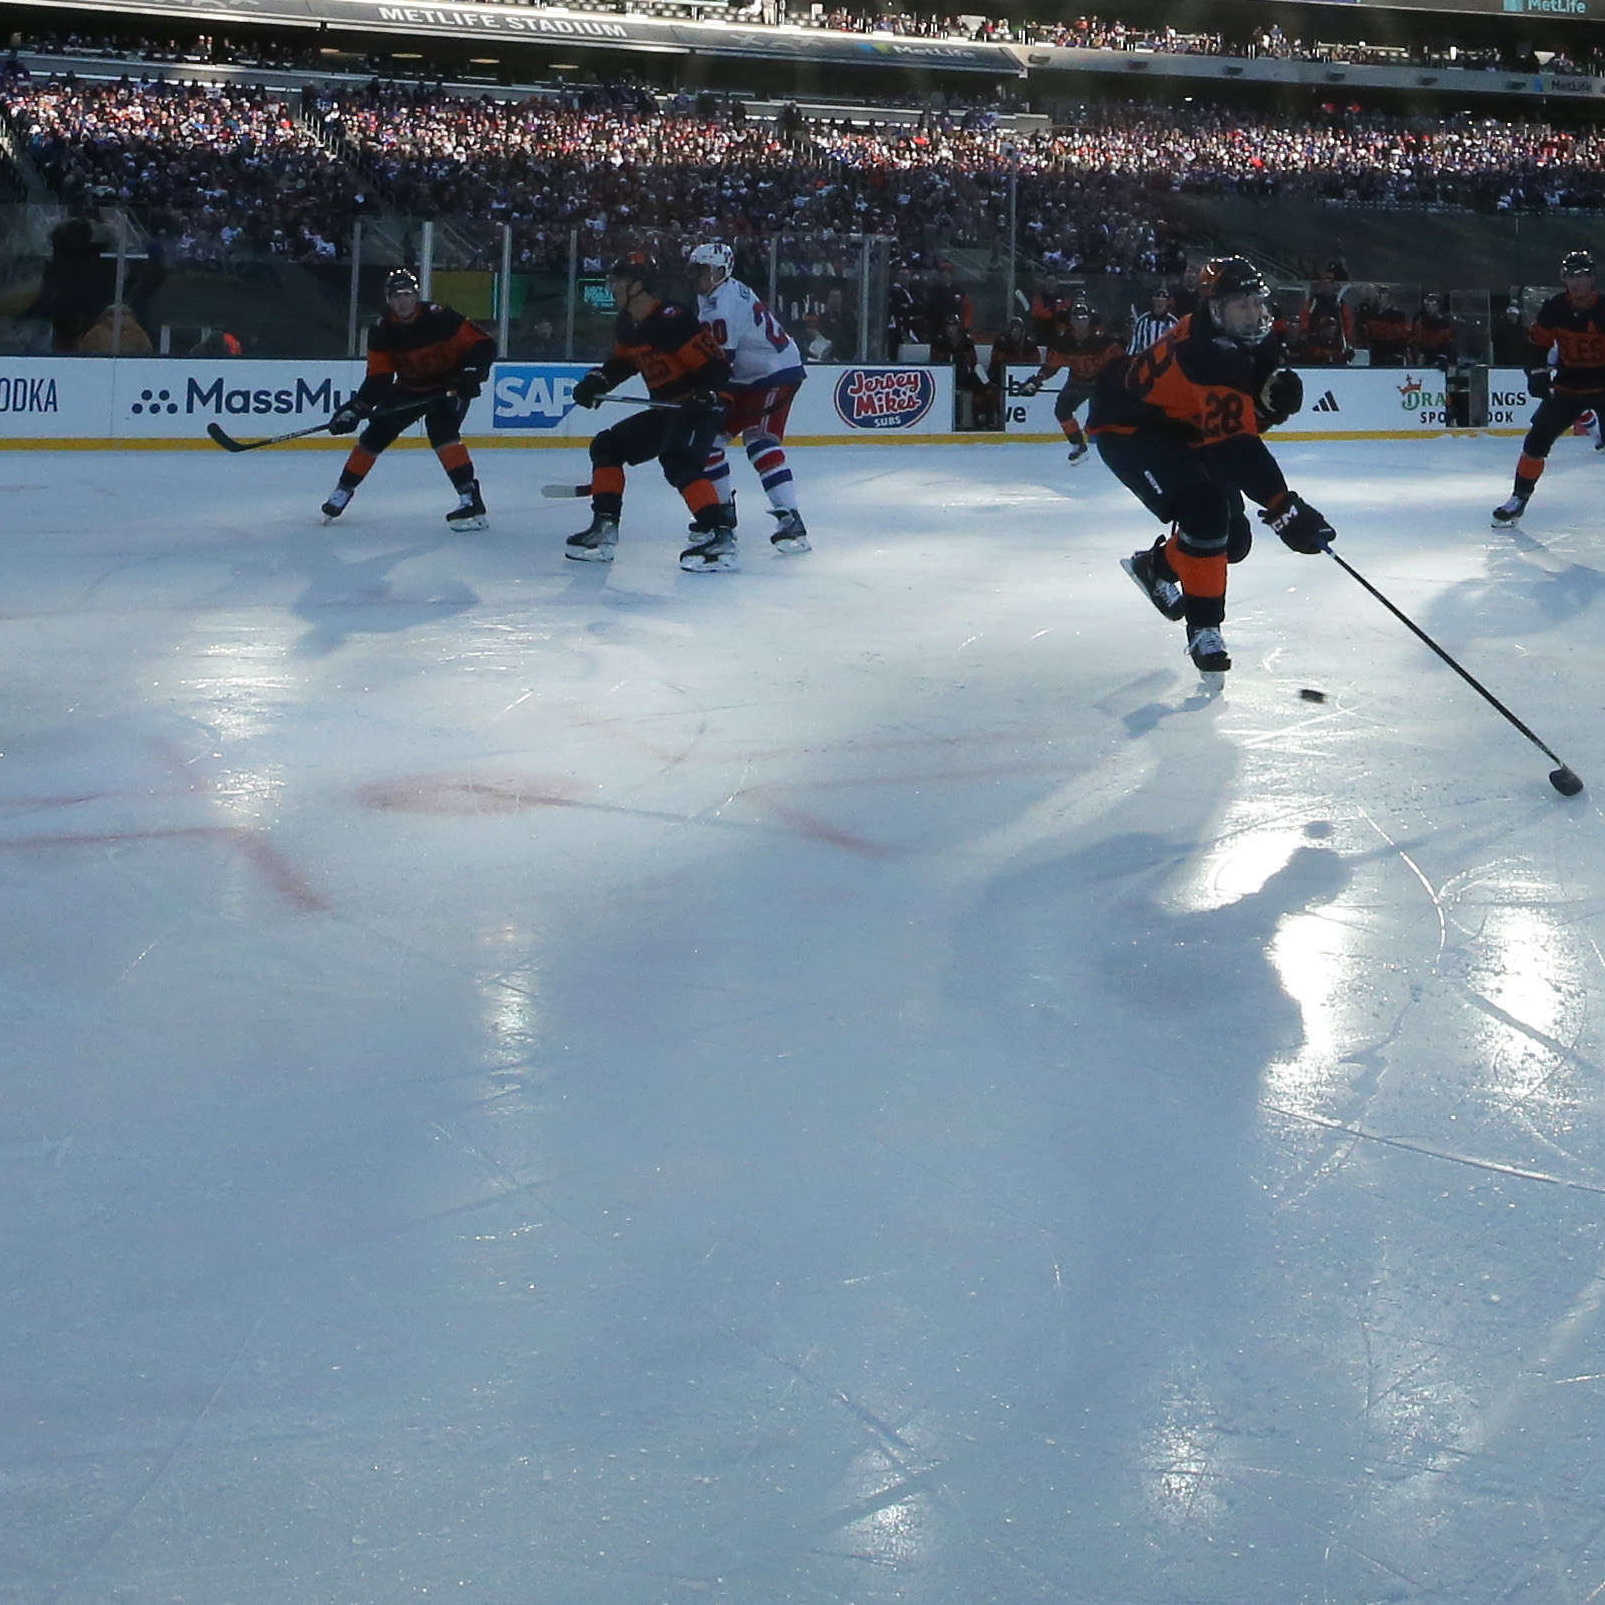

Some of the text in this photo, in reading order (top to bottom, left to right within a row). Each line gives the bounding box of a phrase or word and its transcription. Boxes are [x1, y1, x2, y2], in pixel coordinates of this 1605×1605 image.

[378, 7, 628, 37] METLIFE STADIUM
[894, 45, 976, 59] MetLife
[1551, 80, 1592, 92] MetLife
[849, 369, 921, 395] Jersey
[493, 377, 573, 417] SAP
[854, 390, 921, 419] Mike's
[874, 416, 901, 428] SUBS
[1205, 394, 1242, 437] 28
